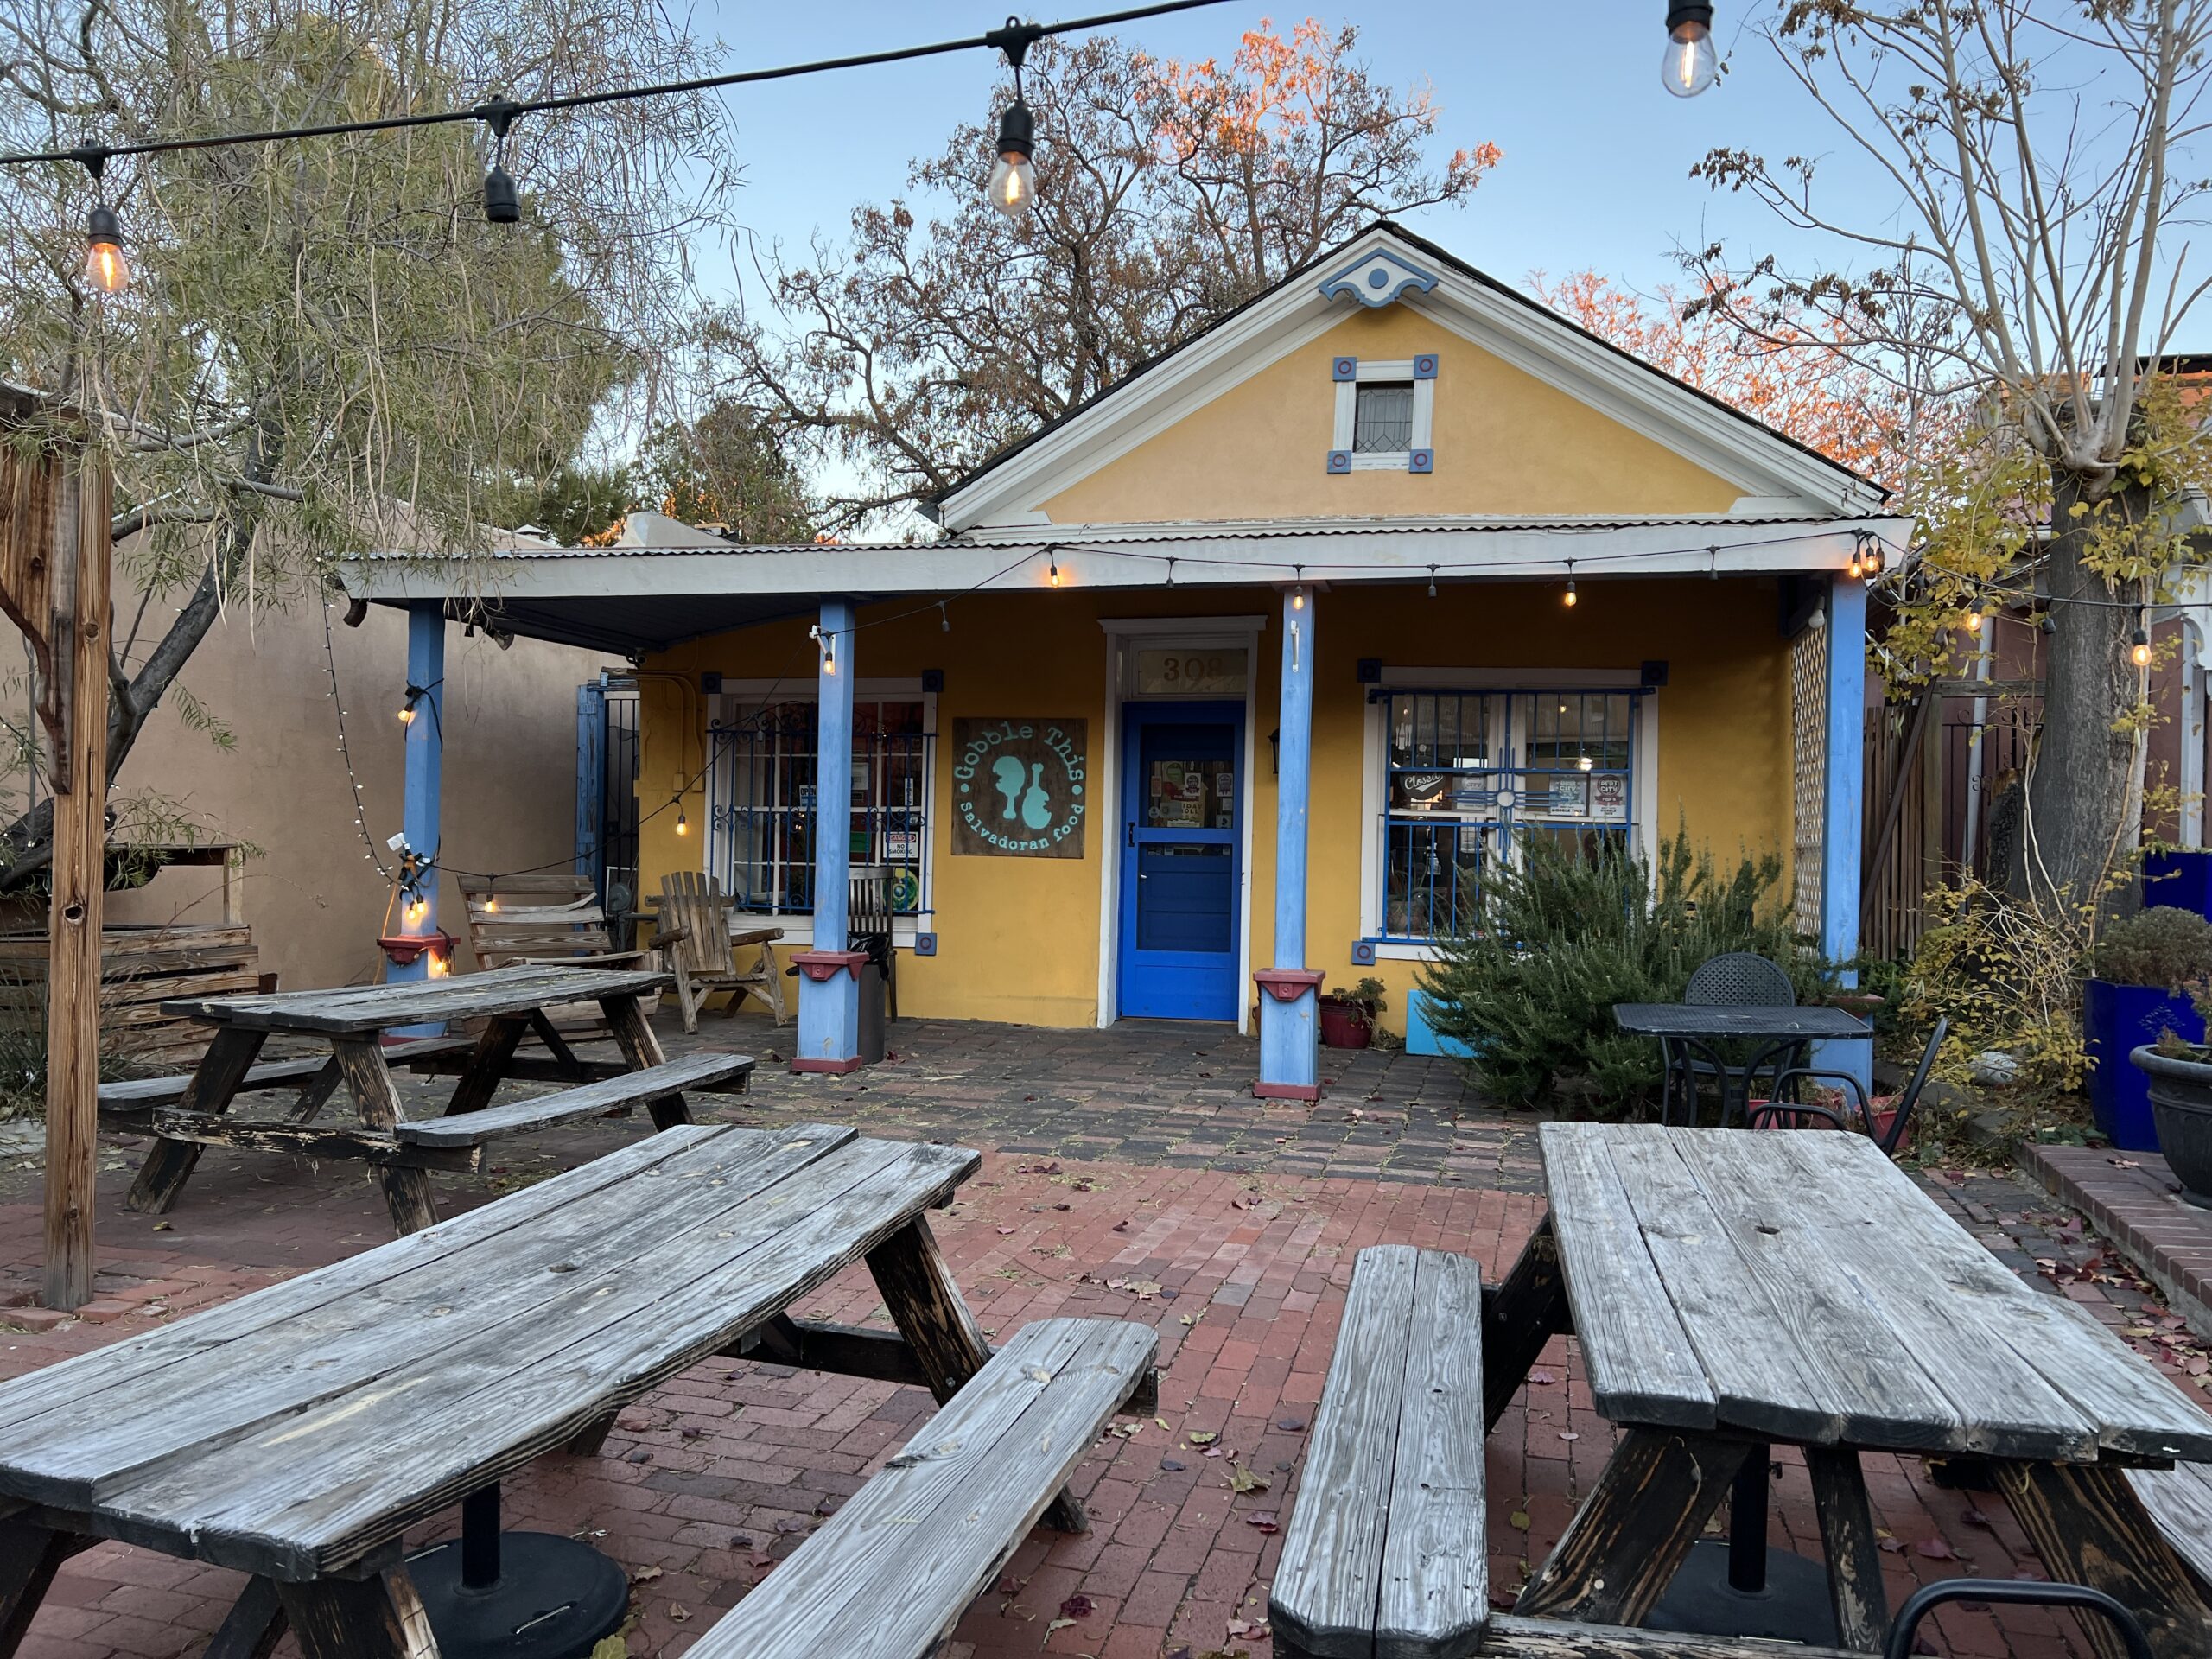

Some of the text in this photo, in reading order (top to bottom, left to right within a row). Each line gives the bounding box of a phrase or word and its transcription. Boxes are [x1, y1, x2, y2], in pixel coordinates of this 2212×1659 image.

[954, 721, 1084, 781] Gobble This
[1053, 804, 1084, 842] food
